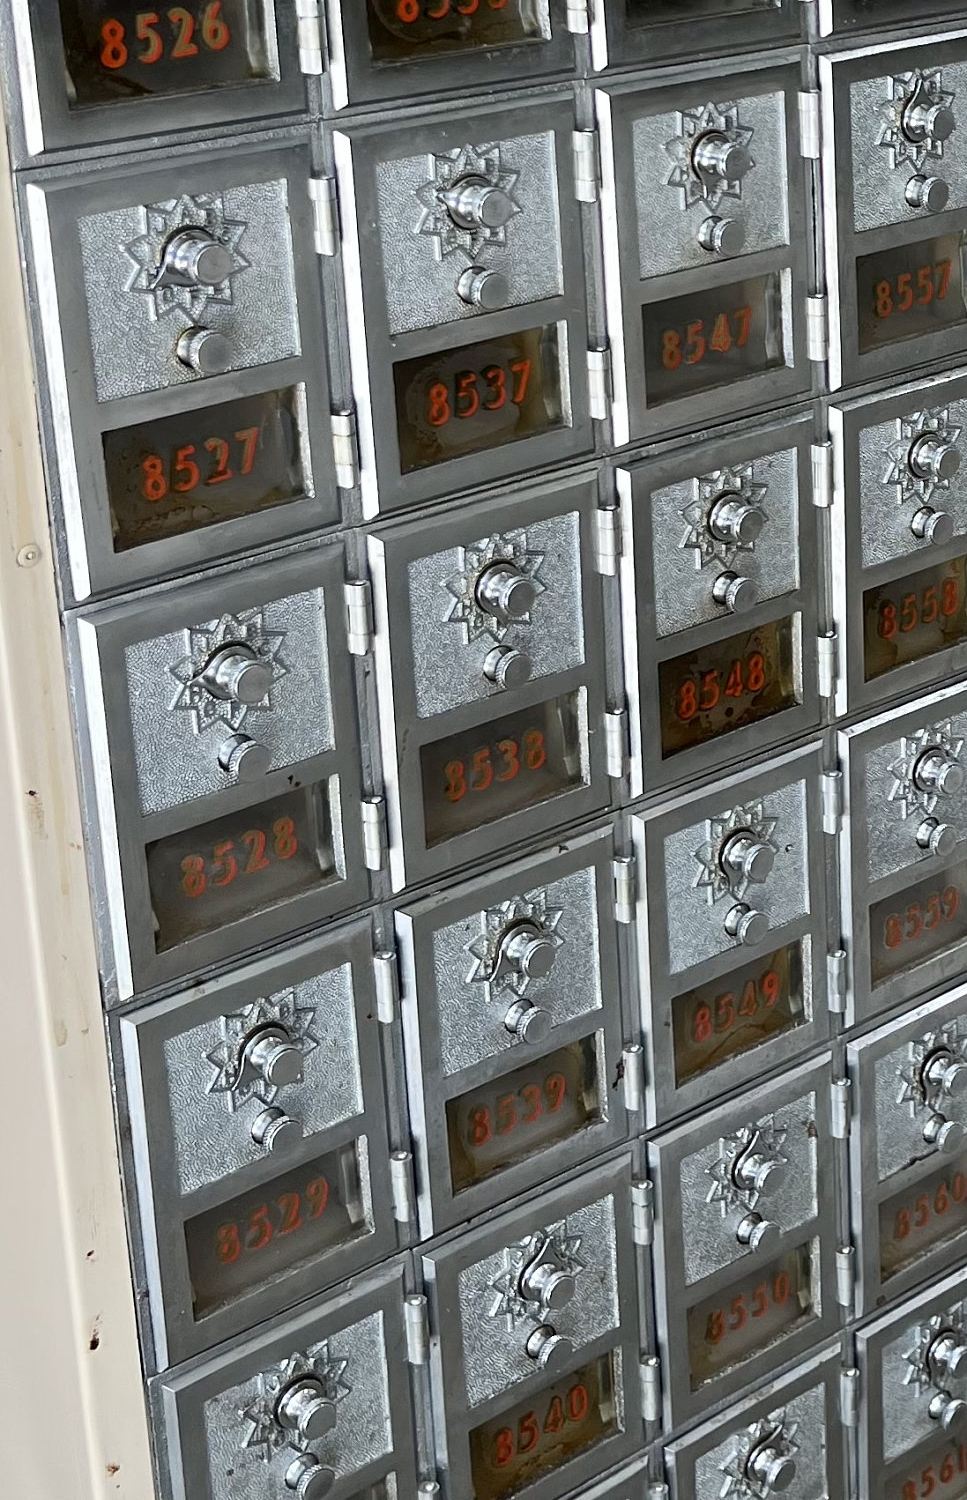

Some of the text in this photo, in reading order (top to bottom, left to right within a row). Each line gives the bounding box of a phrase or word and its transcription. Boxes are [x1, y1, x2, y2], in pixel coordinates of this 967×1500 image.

[99, 0, 230, 70] 8526
[872, 260, 952, 319] 8557
[662, 306, 753, 371] 8547
[427, 360, 529, 425] 8537
[143, 427, 258, 502] 8527
[881, 577, 958, 640] 8558
[677, 660, 766, 722] 8548
[446, 730, 547, 803] 8538
[179, 815, 300, 898] 8528
[887, 884, 960, 950] 8559
[694, 970, 780, 1043] 8549
[468, 1071, 566, 1148] 8539
[216, 1176, 329, 1263] 8529
[894, 1176, 966, 1242] 8560
[706, 1269, 791, 1346] 8550
[495, 1384, 588, 1467] 8540
[902, 1445, 967, 1500] 8561
